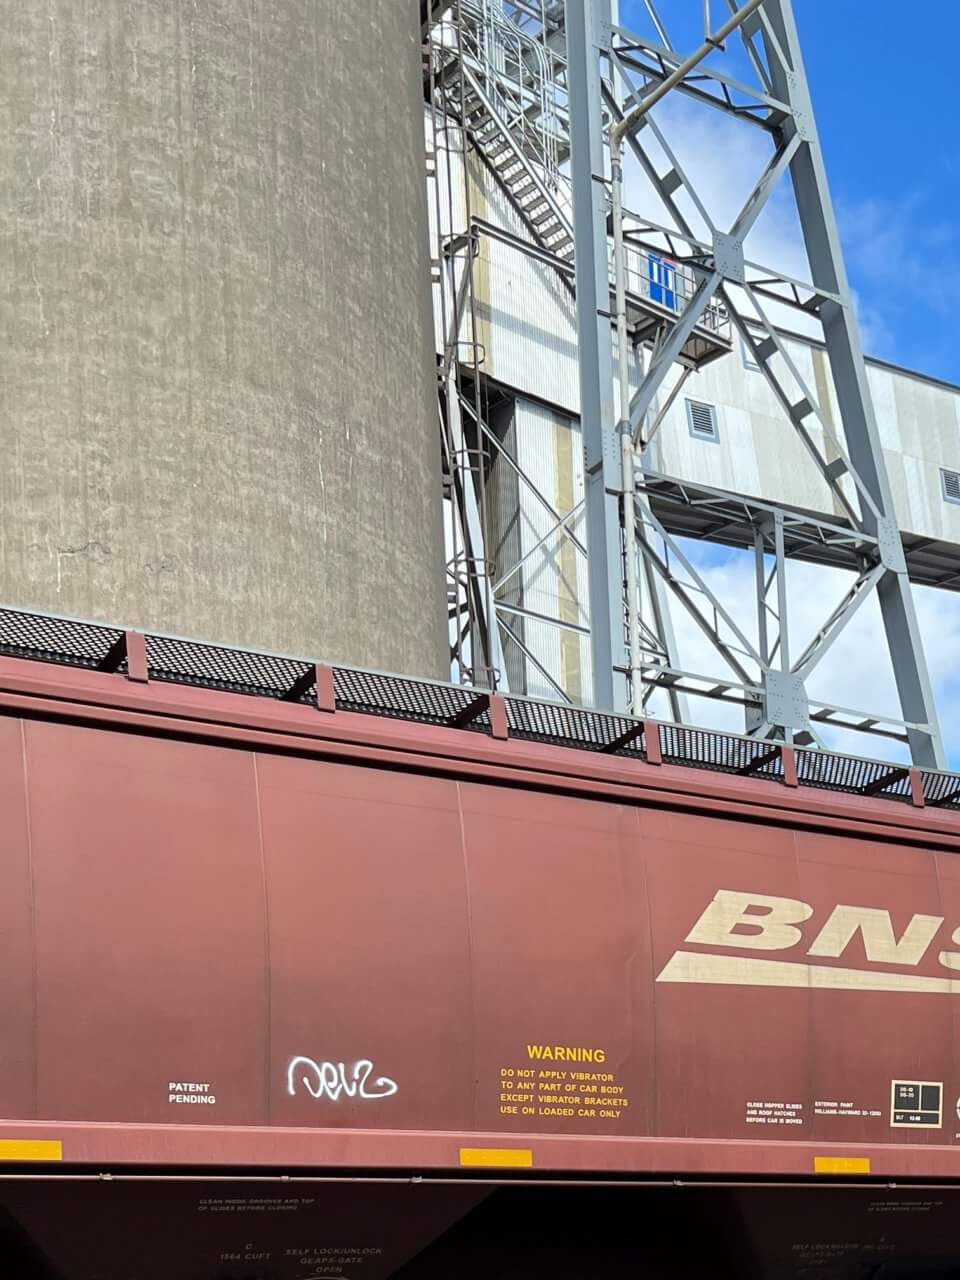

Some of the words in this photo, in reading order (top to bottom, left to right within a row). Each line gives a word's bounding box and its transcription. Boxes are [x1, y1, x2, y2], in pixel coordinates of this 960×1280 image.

[527, 1045, 605, 1063] WARNING
[500, 1069, 514, 1077] DO
[517, 1070, 535, 1078] NOT
[538, 1071, 567, 1079] APPLY
[570, 1072, 614, 1082] VIBRATOR
[168, 1083, 210, 1092] PATENT
[500, 1081, 513, 1089] TO
[517, 1082, 535, 1090] ANY
[538, 1083, 562, 1091] PART
[565, 1084, 577, 1092] OF
[579, 1084, 597, 1093] CAR
[600, 1086, 624, 1094] BODY
[168, 1095, 216, 1104] PENDING
[500, 1094, 535, 1102] EXCEPT
[538, 1095, 580, 1104] VIBRATOR
[584, 1097, 628, 1106] BRACKETS
[500, 1106, 518, 1114] USE
[539, 1107, 574, 1116] LOADED
[578, 1109, 595, 1117] CAR
[600, 1110, 621, 1118] ONLY
